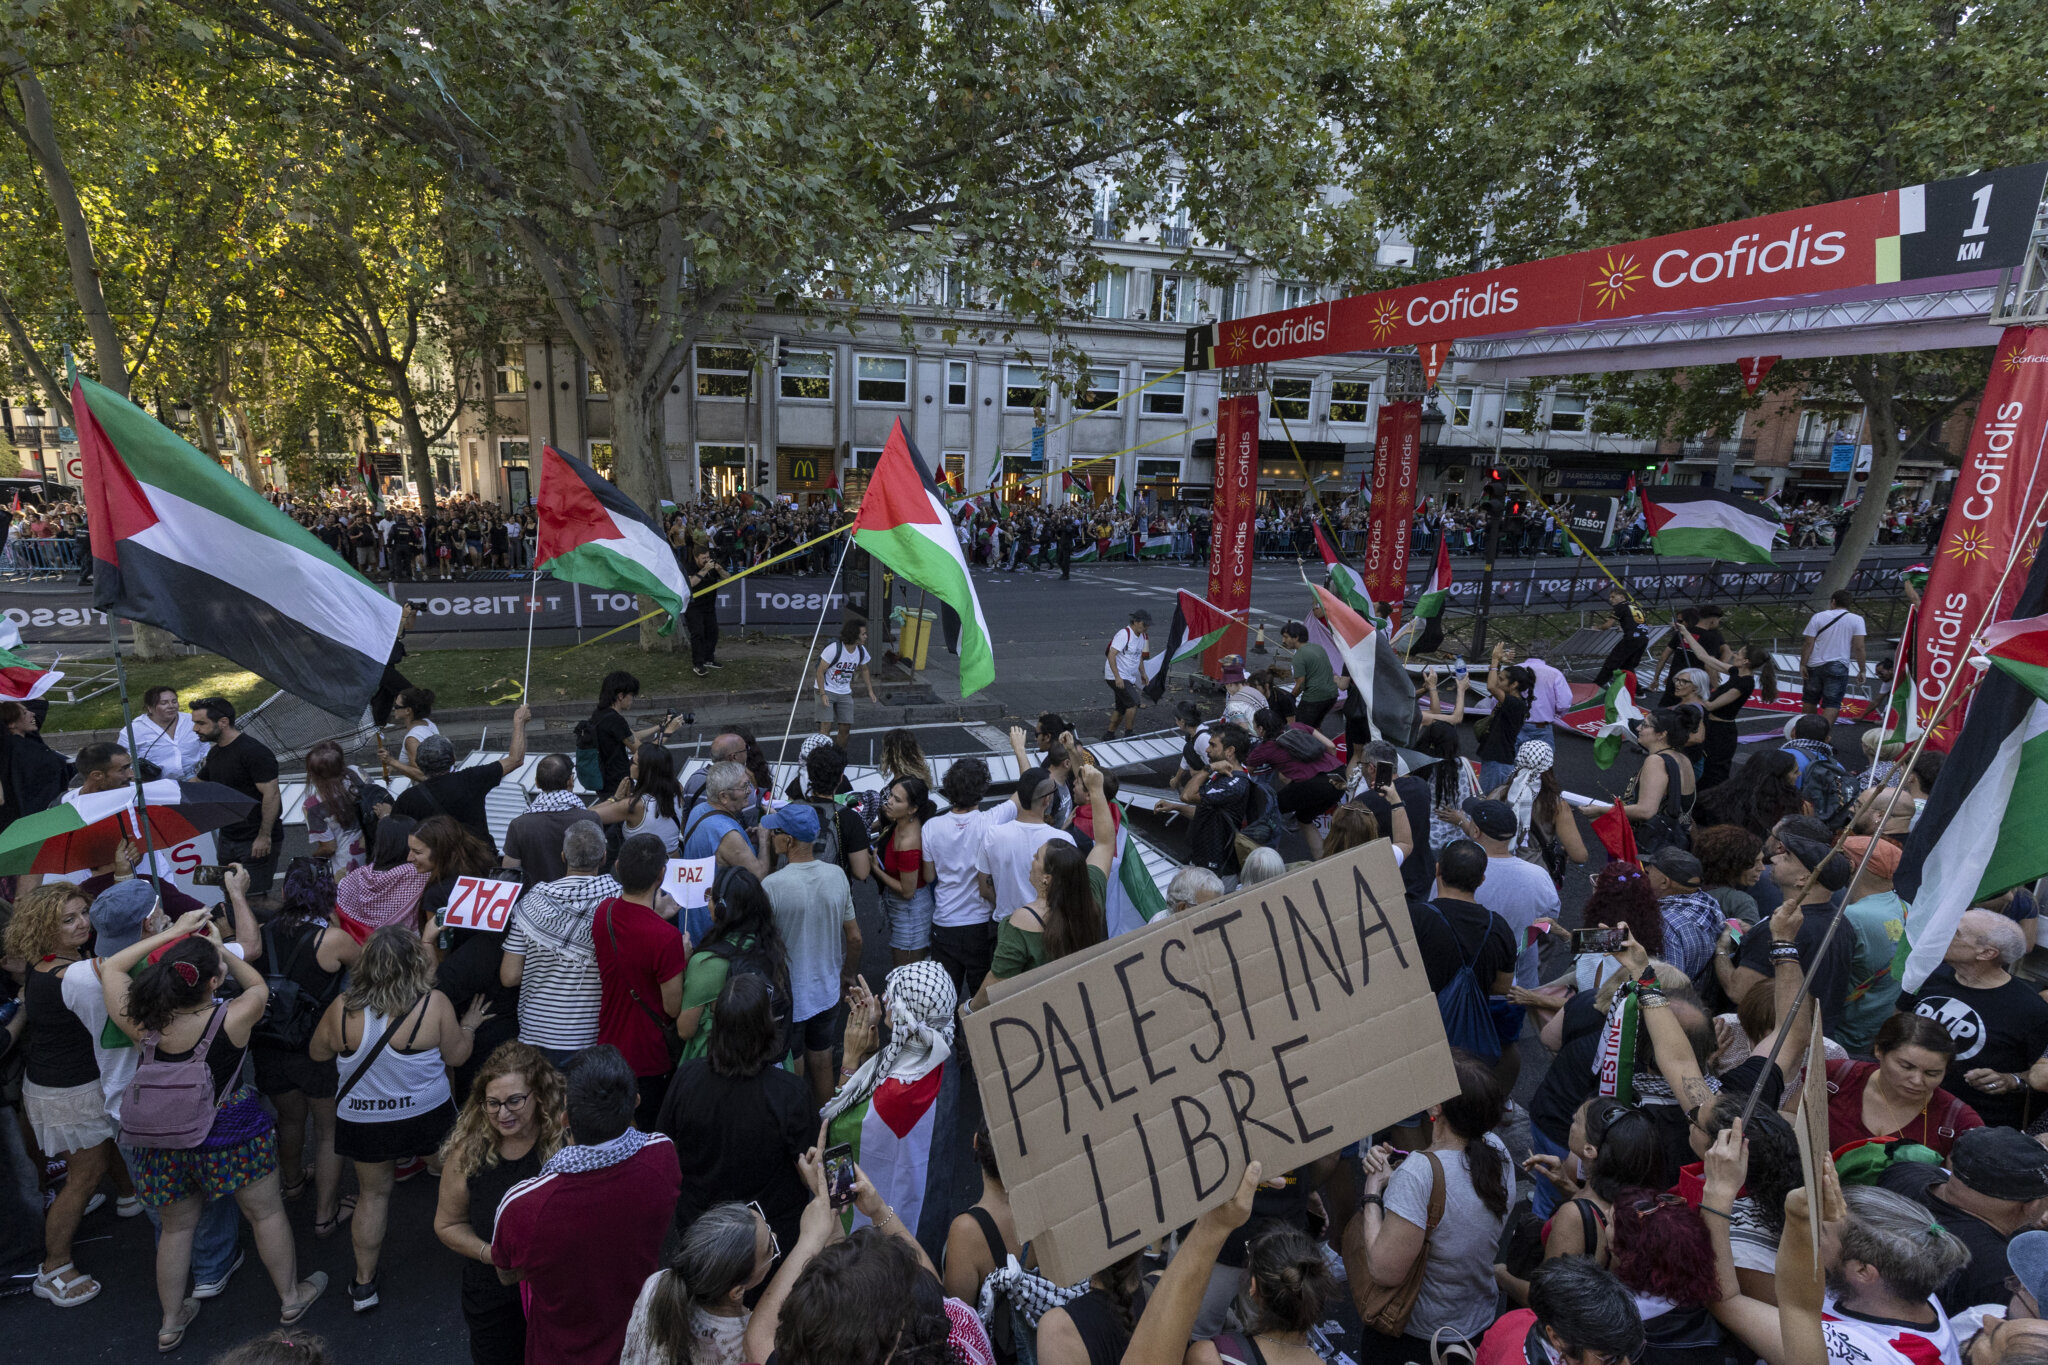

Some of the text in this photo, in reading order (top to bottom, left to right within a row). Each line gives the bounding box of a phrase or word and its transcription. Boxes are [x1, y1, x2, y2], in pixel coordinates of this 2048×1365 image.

[1962, 184, 1994, 238] 1
[1652, 223, 1847, 289] Cofidis
[1956, 241, 1985, 262] KM
[1406, 282, 1519, 327] Cofidis
[1192, 331, 1200, 356] 1
[1252, 315, 1325, 349] Cofidis
[1428, 343, 1438, 367] 1
[1750, 356, 1760, 376] 1
[1216, 432, 1226, 489] Cofidis
[1238, 430, 1251, 489] Cofidis
[1375, 435, 1389, 489] Cofidis
[1400, 433, 1413, 488] Cofidis
[1962, 401, 2024, 521] Cofidis
[1212, 521, 1223, 576] Cofidis
[1234, 520, 1248, 577] Cofidis
[1369, 519, 1382, 570] Cofidis
[1393, 519, 1406, 571] Cofidis
[1573, 517, 1606, 529] TISSOT
[836, 661, 857, 671] GAZA
[1918, 591, 1968, 702] Cofidis
[678, 866, 703, 883] PAZ
[446, 878, 520, 930] PAZ
[989, 865, 1410, 1157] PALESTINA
[348, 1095, 416, 1111] JUST DO IT.
[1082, 1035, 1334, 1250] LIBRE
